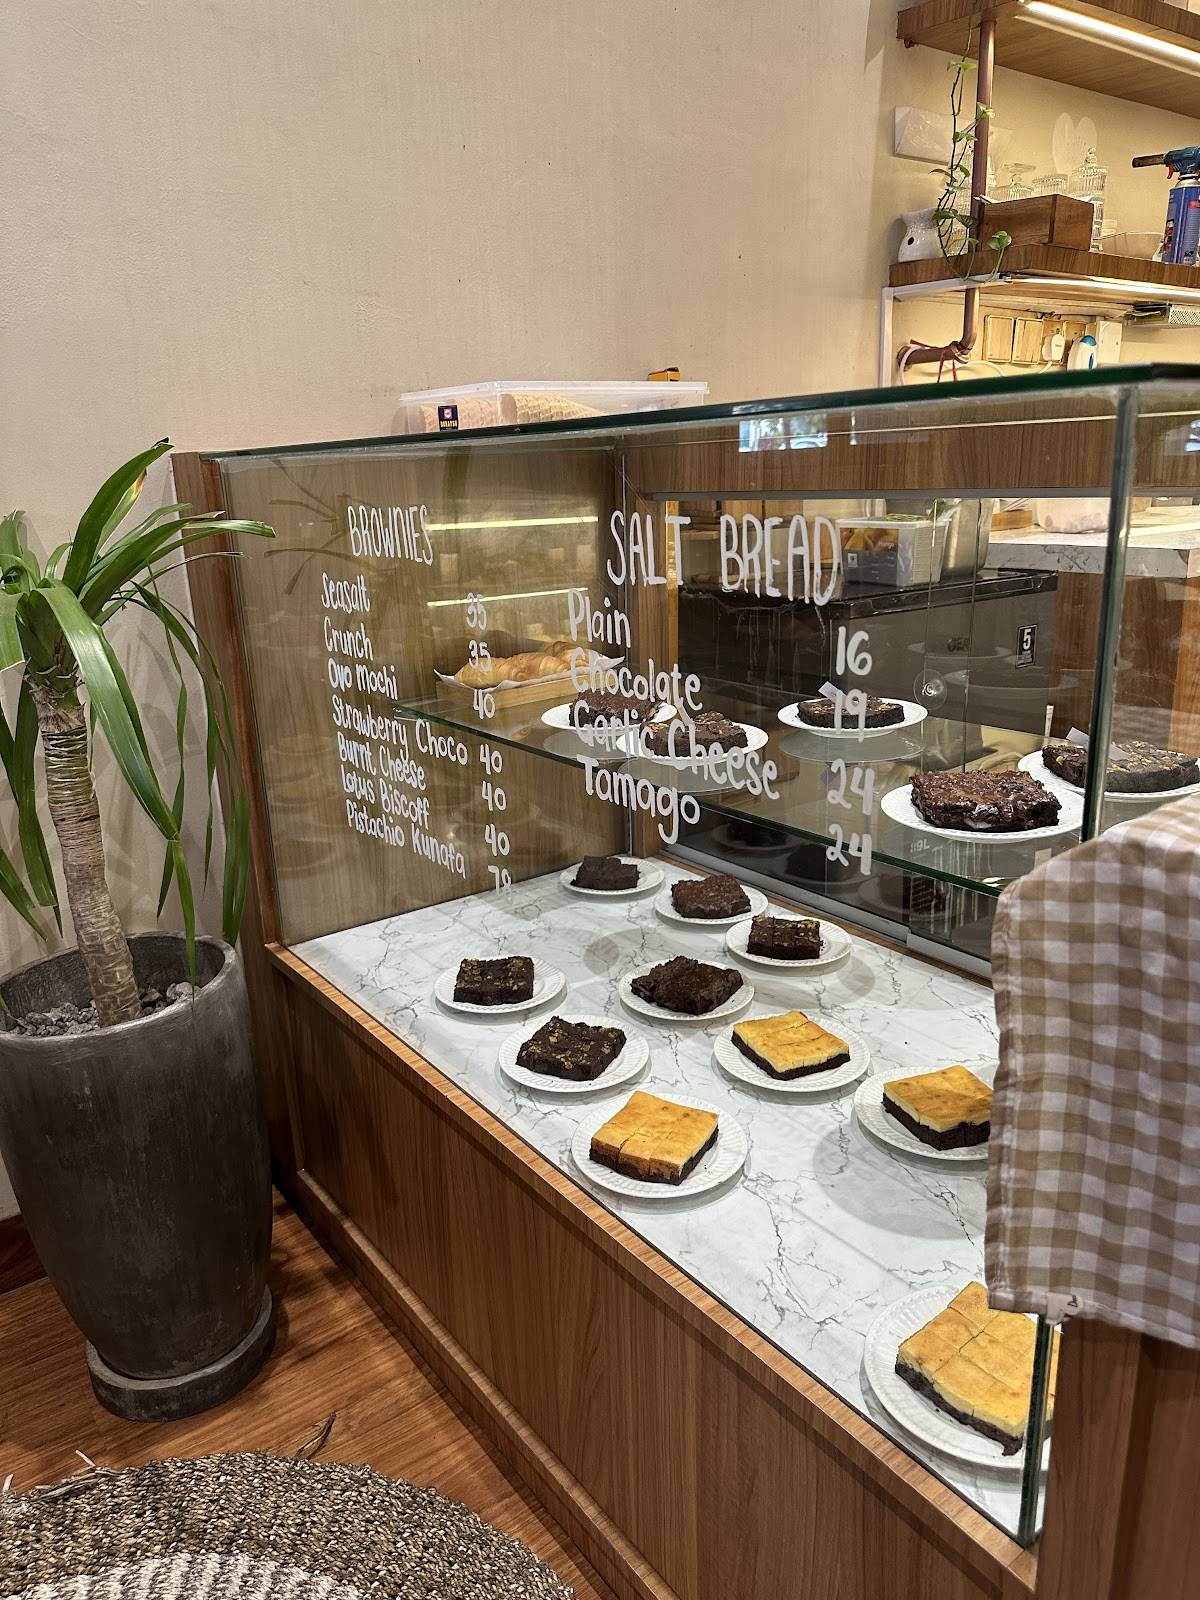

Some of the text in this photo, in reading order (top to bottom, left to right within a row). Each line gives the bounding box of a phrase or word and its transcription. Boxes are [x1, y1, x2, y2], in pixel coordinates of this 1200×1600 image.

[347, 504, 434, 566] BROWNIES
[607, 510, 840, 606] SALT BREAD
[321, 572, 487, 630] Seasalt 35
[567, 588, 632, 648] Plain
[1022, 628, 1032, 650] 5
[323, 616, 492, 672] Crunch 35
[835, 626, 873, 676] 16
[328, 658, 353, 691] Ovo
[473, 689, 496, 719] 40
[570, 647, 868, 743] Chocolate 19
[332, 694, 503, 775] Strawberry Choco 40
[337, 731, 507, 811] Burnt Cheese 40
[574, 700, 876, 815] Garlic Cheese 24
[341, 765, 510, 857] Lotus Biscoff 40
[346, 799, 405, 848] Pistachio
[411, 822, 466, 878] Kunafa
[577, 754, 873, 875] Tamago 24
